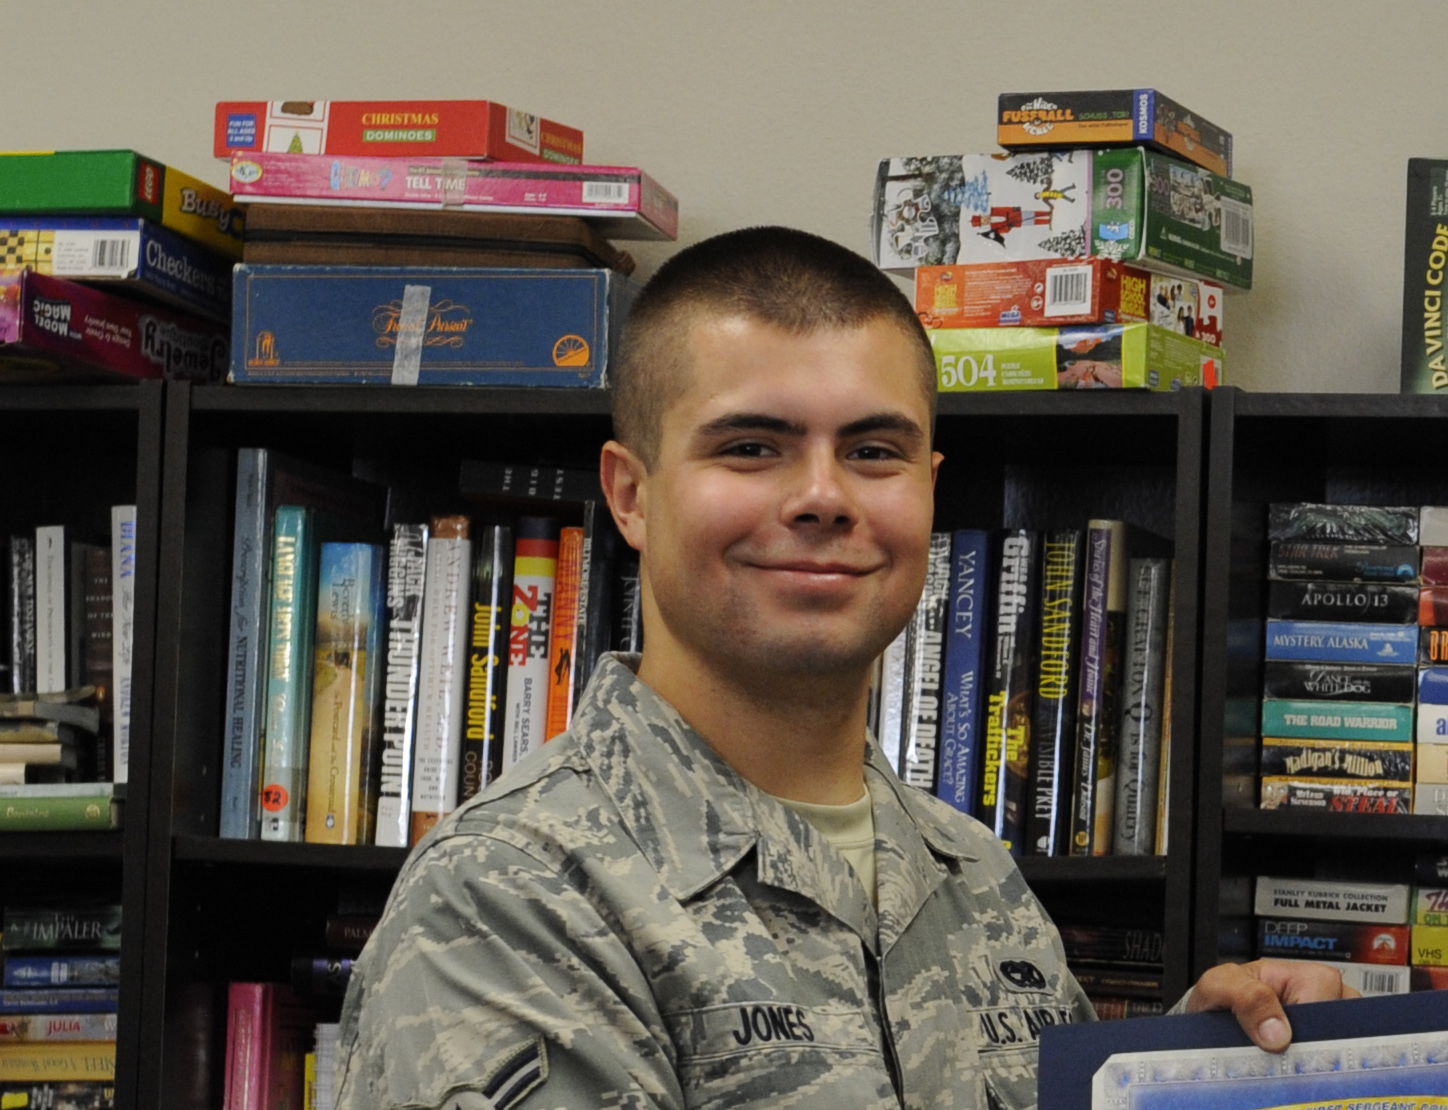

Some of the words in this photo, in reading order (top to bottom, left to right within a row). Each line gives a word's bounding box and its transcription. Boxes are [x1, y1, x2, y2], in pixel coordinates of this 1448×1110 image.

[361, 113, 439, 126] CHRISTMAS
[1139, 94, 1149, 134] KOSMOS
[366, 130, 433, 141] DOMINOES
[405, 176, 432, 189] TELL
[1106, 168, 1124, 210] 300
[1424, 290, 1443, 356] VINCI
[941, 354, 996, 387] 504
[1045, 542, 1076, 592] JOHN
[955, 550, 977, 639] YANCEY
[1301, 593, 1367, 607] APOLLO
[1373, 593, 1389, 607] 13
[474, 603, 502, 647] John
[508, 585, 539, 665] ZONE
[527, 592, 551, 659] THE
[1039, 597, 1073, 699] SANDFORD
[1329, 637, 1369, 650] ALASKA
[384, 619, 414, 729] THUNDER
[467, 654, 498, 740] Sandford
[1284, 714, 1308, 726] THE
[1310, 714, 1340, 727] ROAD
[1343, 716, 1398, 730] WARRIOR
[983, 690, 1006, 807] Traffickers
[1285, 749, 1341, 775] Madigan's
[1343, 754, 1384, 776] Million
[1034, 786, 1052, 820] PREY
[1273, 898, 1300, 909] FULL
[1305, 899, 1340, 911] METAL
[1345, 901, 1387, 914] JACKET
[1274, 888, 1305, 898] STANLEY
[1308, 890, 1339, 900] KUBRICK
[1342, 892, 1388, 902] COLLECTION
[33, 921, 102, 941] IMPALER
[1265, 922, 1308, 935] DEEP
[1265, 935, 1337, 950] IMPACT
[47, 1020, 81, 1034] JULIA
[733, 1007, 815, 1046] JONES
